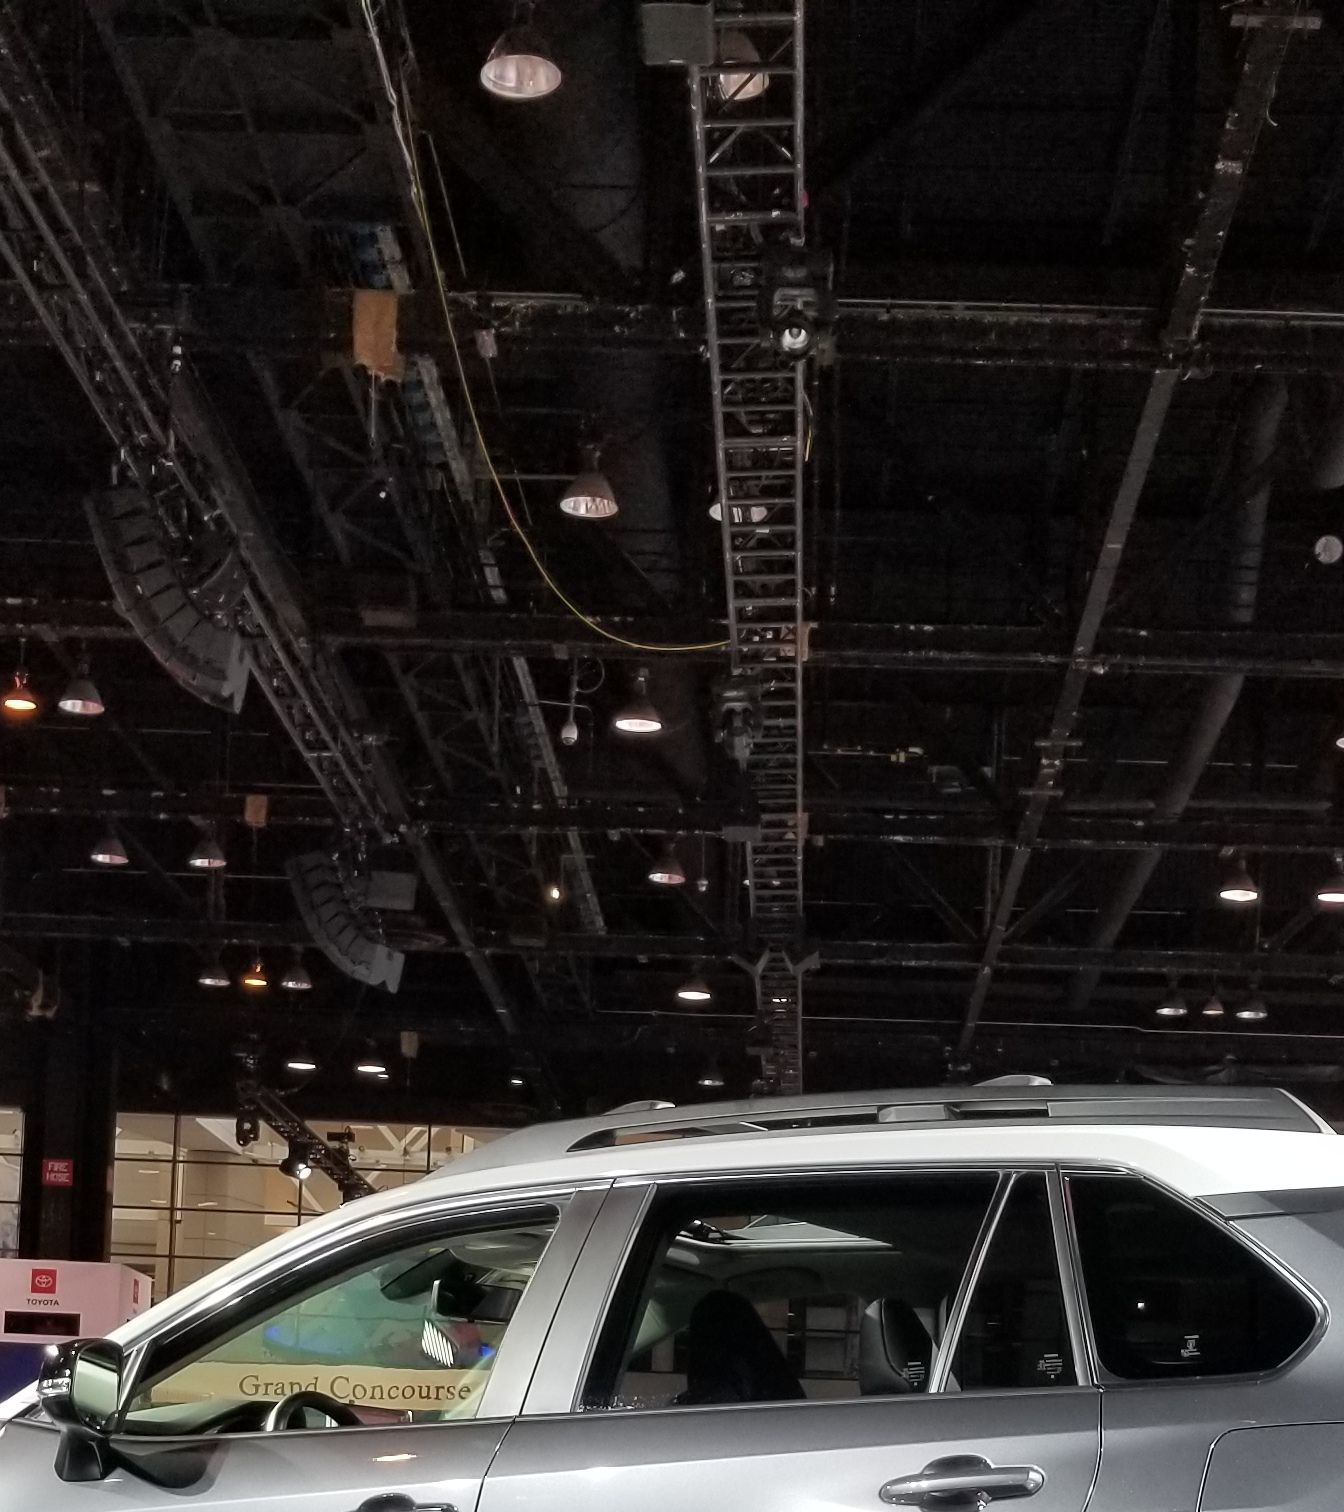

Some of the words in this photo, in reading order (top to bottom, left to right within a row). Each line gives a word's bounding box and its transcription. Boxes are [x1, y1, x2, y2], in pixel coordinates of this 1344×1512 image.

[48, 1161, 69, 1172] FIRE
[46, 1172, 70, 1182] HOSE
[26, 1298, 60, 1306] TOYOTA
[239, 1375, 319, 1397] Grand
[330, 1376, 472, 1401] Concourse
